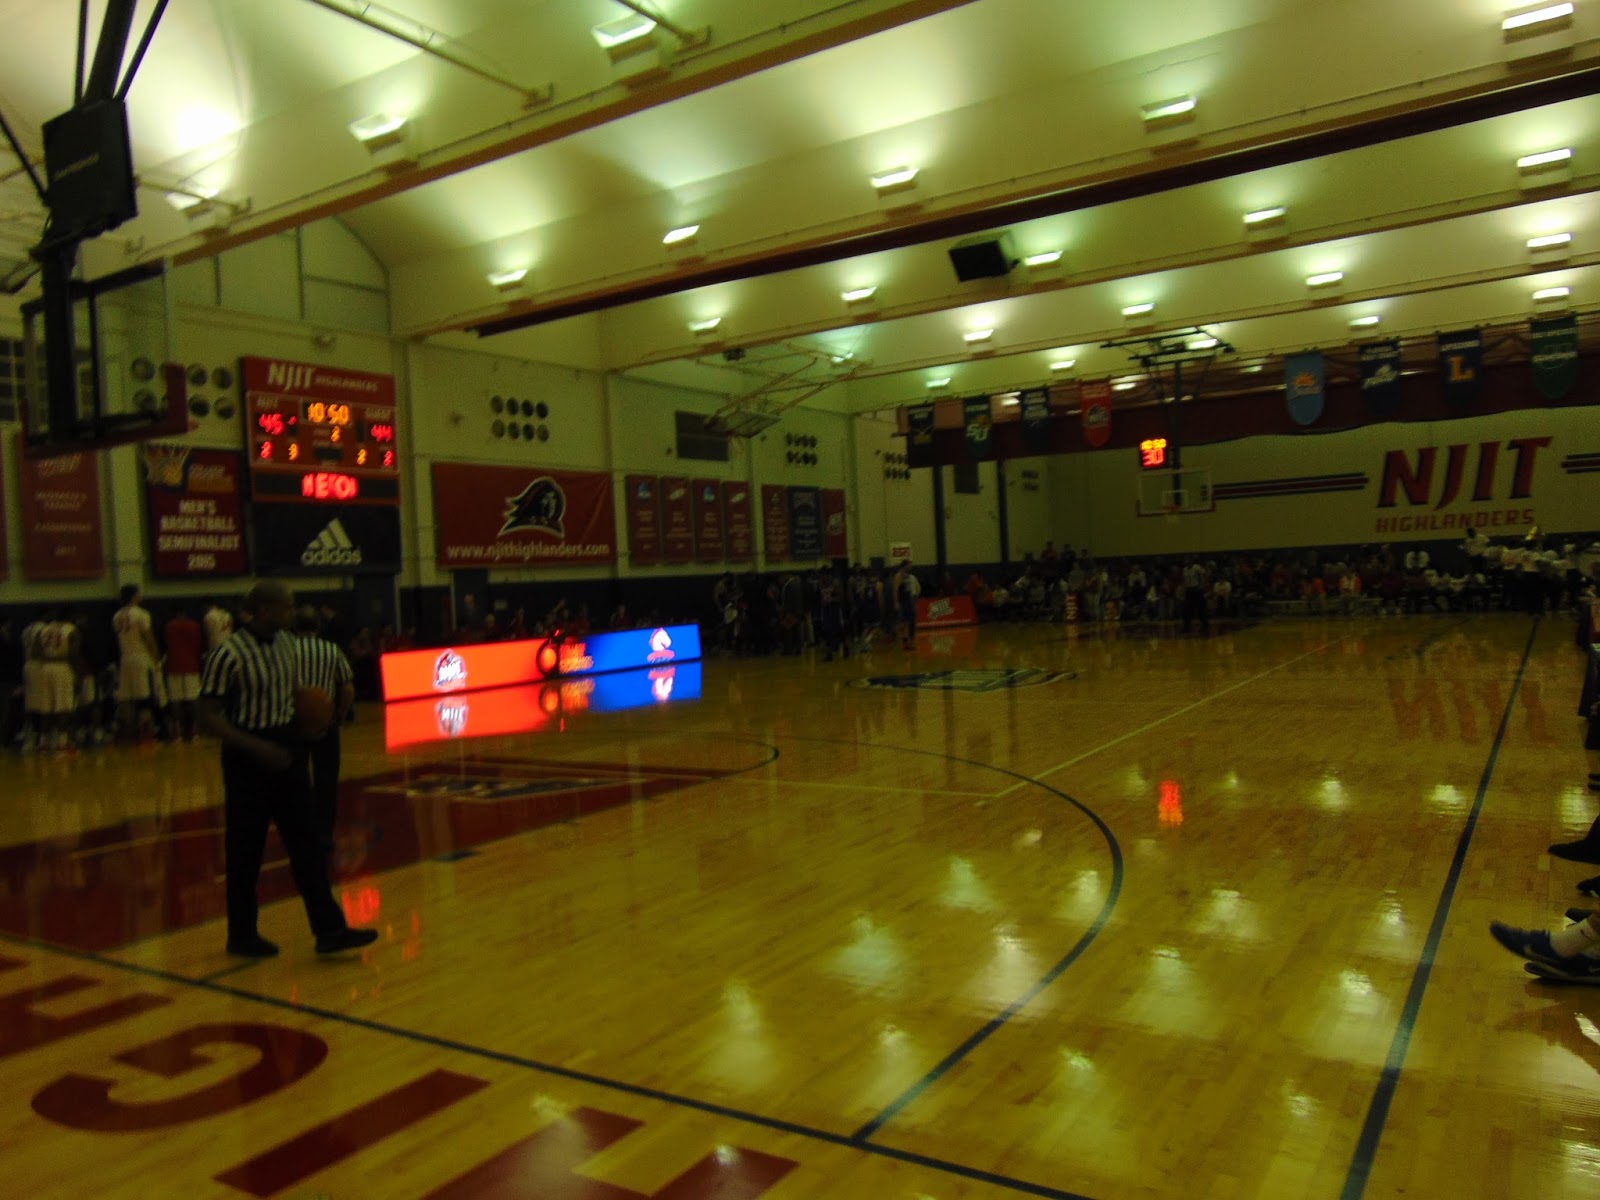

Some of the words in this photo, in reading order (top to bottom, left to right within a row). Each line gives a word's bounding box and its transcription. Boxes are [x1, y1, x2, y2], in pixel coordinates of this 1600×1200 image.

[267, 362, 316, 392] NJIT
[1377, 436, 1554, 510] NJIT
[161, 514, 235, 533] BASKETBALL
[1376, 509, 1535, 533] HIGHLANDERS
[301, 546, 362, 567] adidas
[447, 541, 610, 562] www.njithighlanders.com
